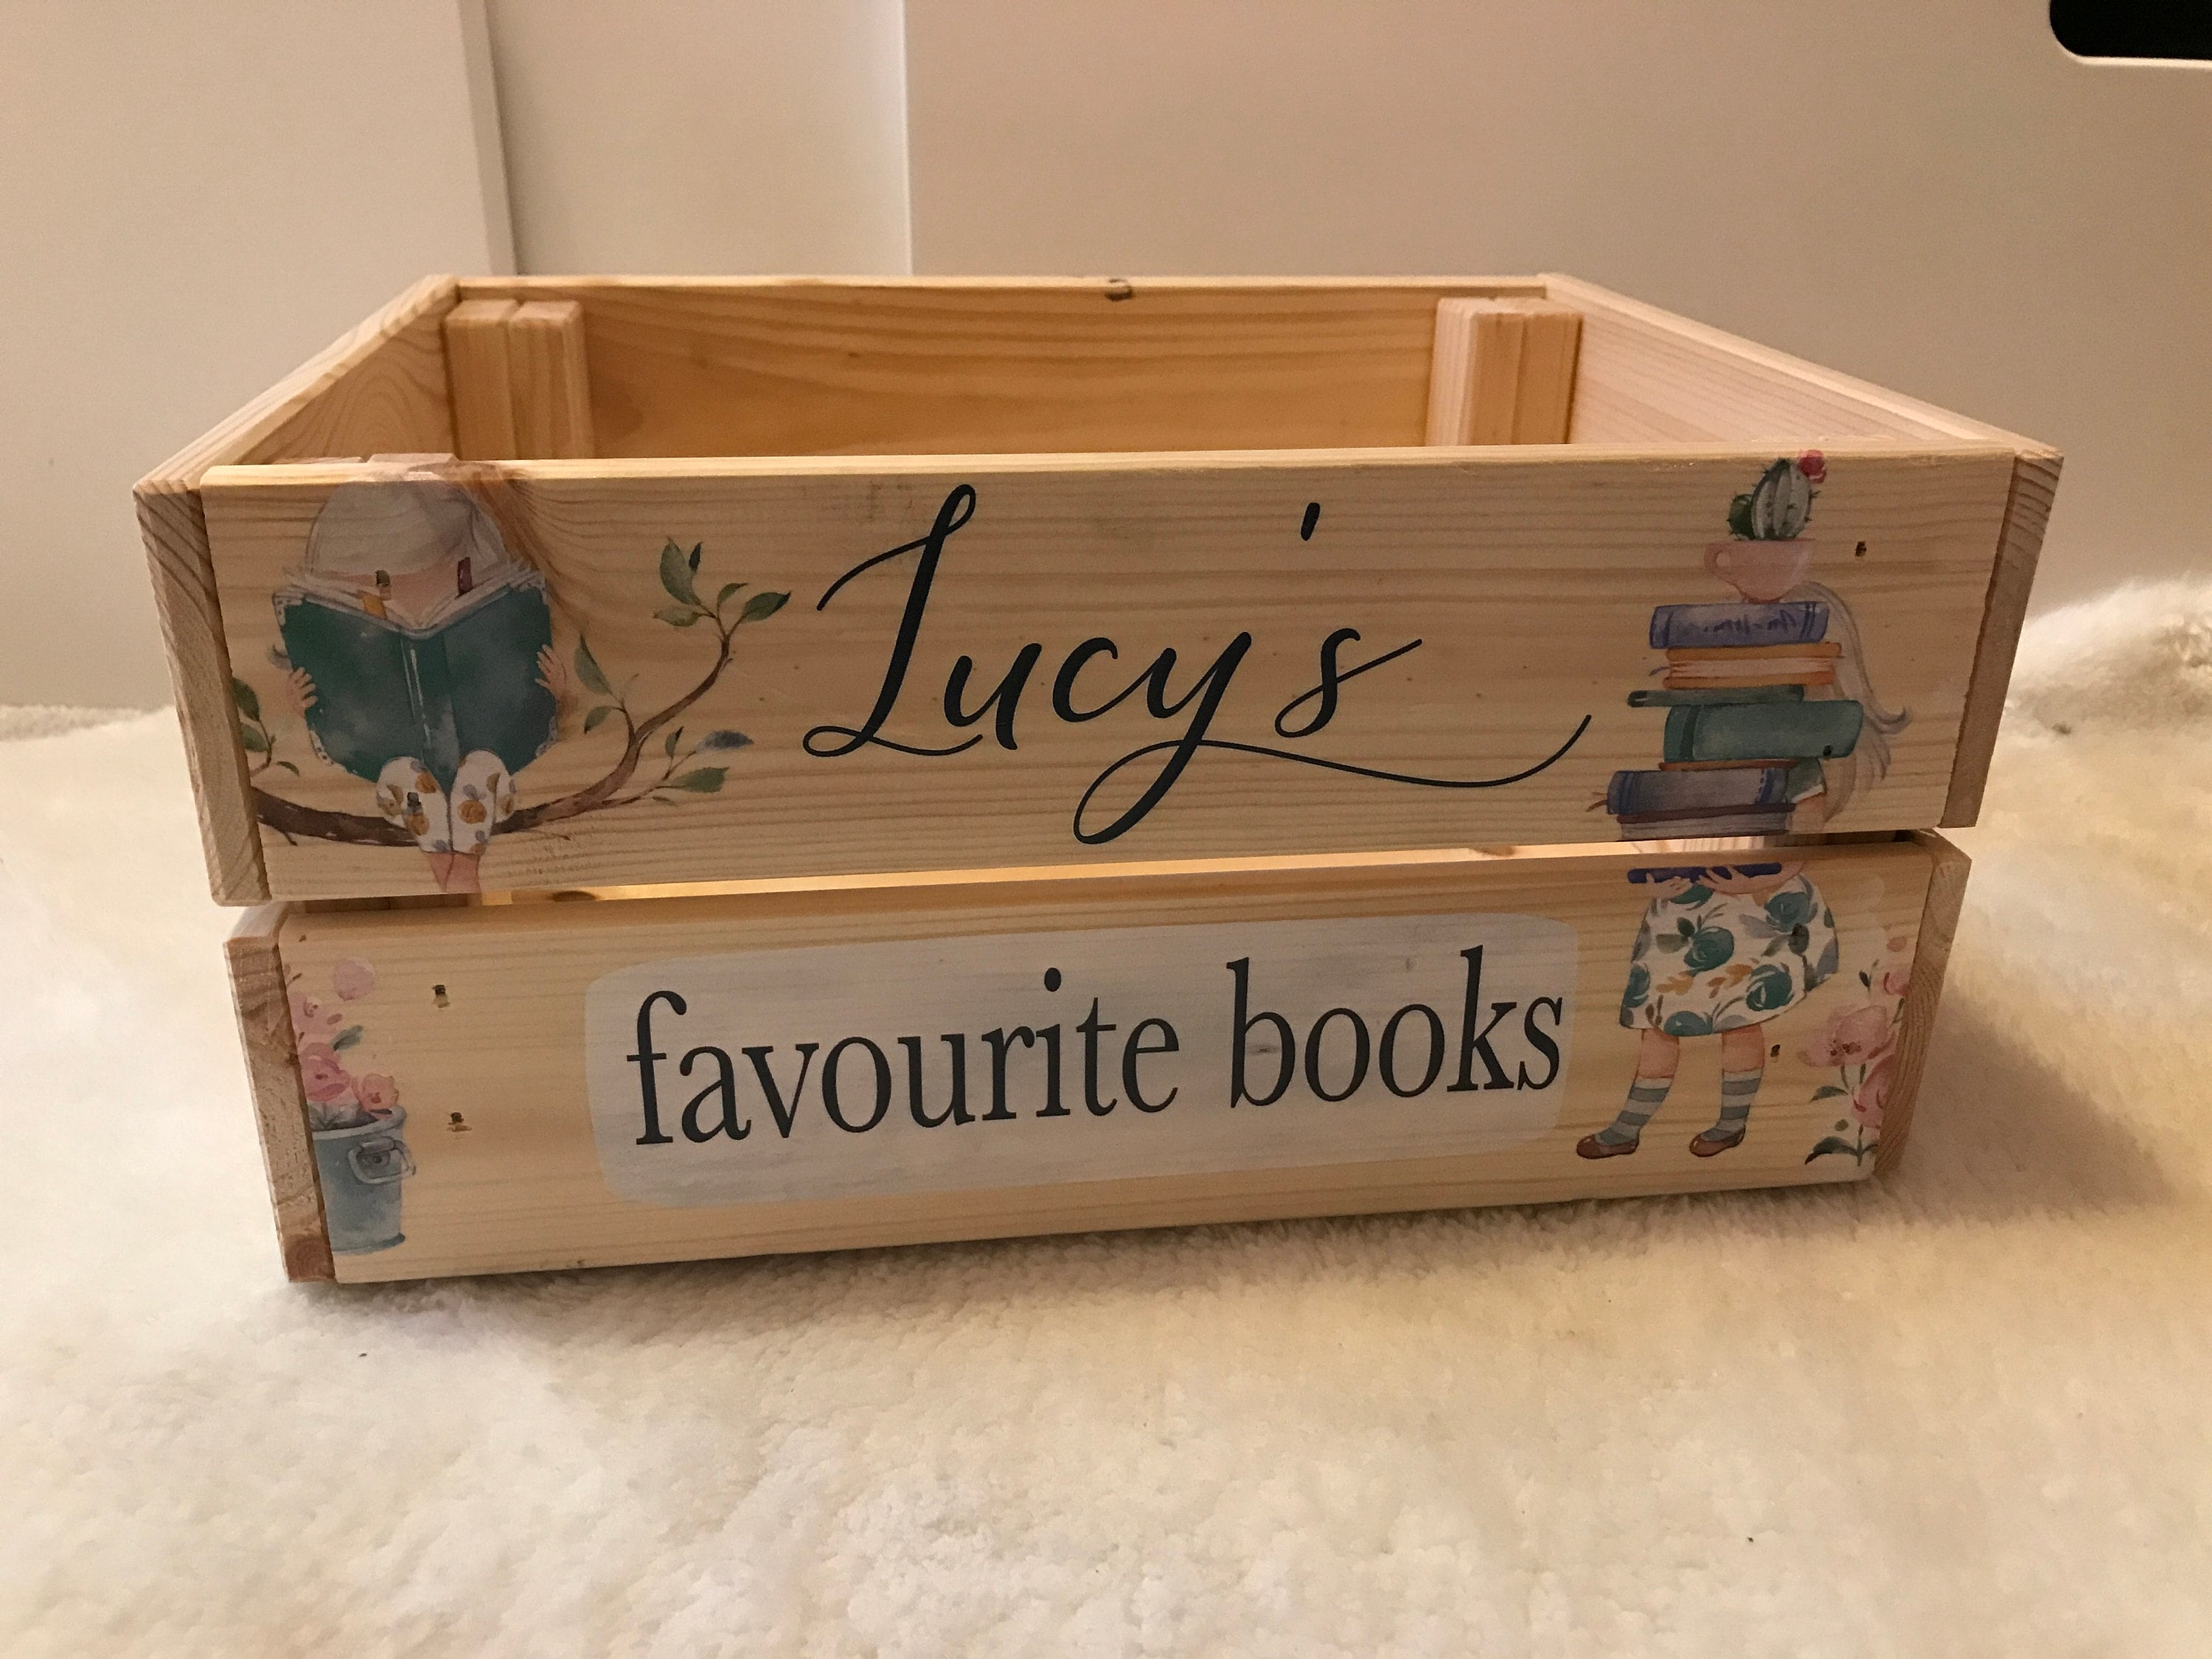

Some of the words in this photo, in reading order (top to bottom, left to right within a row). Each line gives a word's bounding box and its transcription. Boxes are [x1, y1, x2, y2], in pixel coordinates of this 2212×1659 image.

[802, 483, 1593, 845] Lucy's
[625, 967, 1180, 1147] favourite
[1225, 944, 1564, 1109] books
